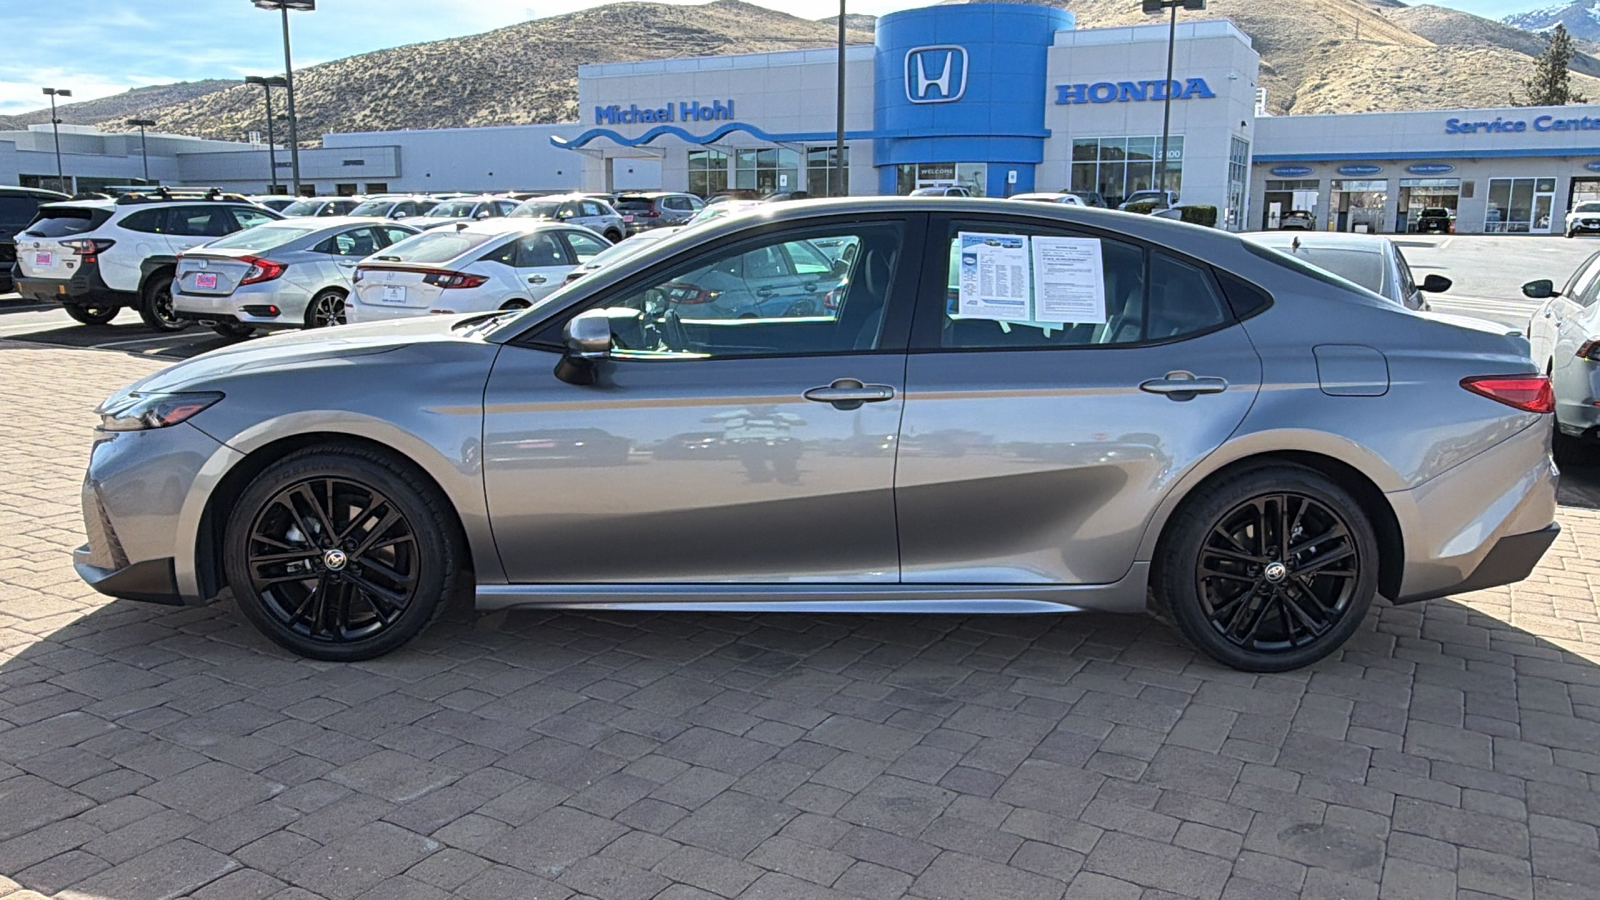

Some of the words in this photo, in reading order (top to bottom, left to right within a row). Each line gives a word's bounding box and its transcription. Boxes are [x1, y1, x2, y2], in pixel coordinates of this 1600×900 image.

[1055, 78, 1216, 105] HONDA
[595, 102, 675, 125] Michael
[679, 99, 734, 122] Hohl
[1445, 116, 1527, 134] Service
[1158, 150, 1181, 159] 200
